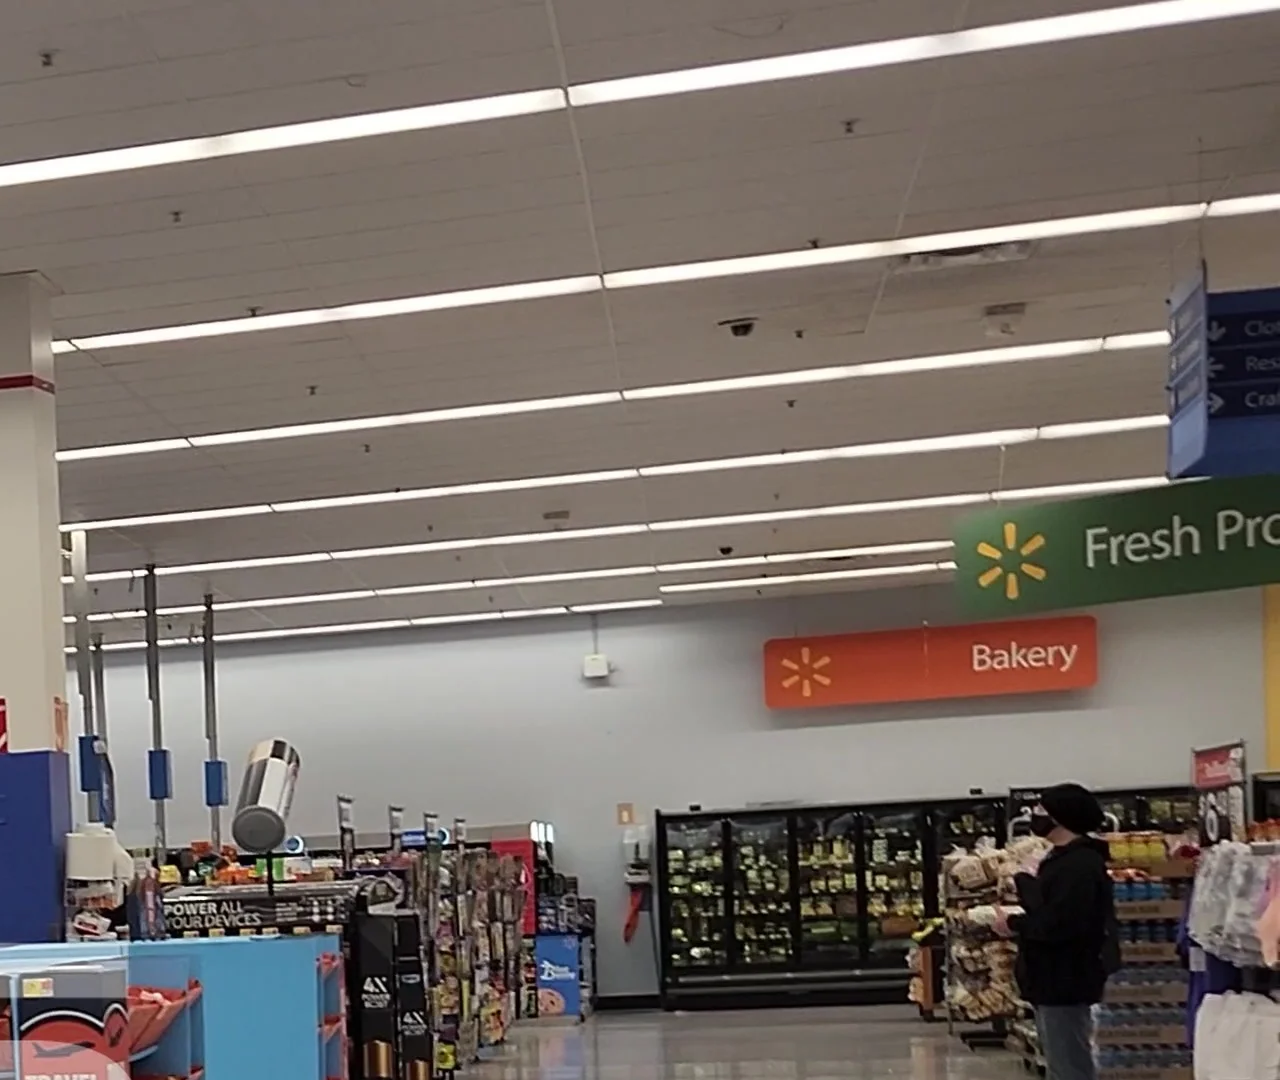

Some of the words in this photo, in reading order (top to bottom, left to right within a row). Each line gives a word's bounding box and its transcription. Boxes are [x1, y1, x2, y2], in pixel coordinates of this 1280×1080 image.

[1085, 515, 1201, 568] Fresh
[972, 642, 1079, 674] Bakery
[163, 903, 217, 916] POWER
[219, 900, 243, 914] ALL
[164, 915, 203, 930] YOUR
[204, 913, 262, 927] DEVICES
